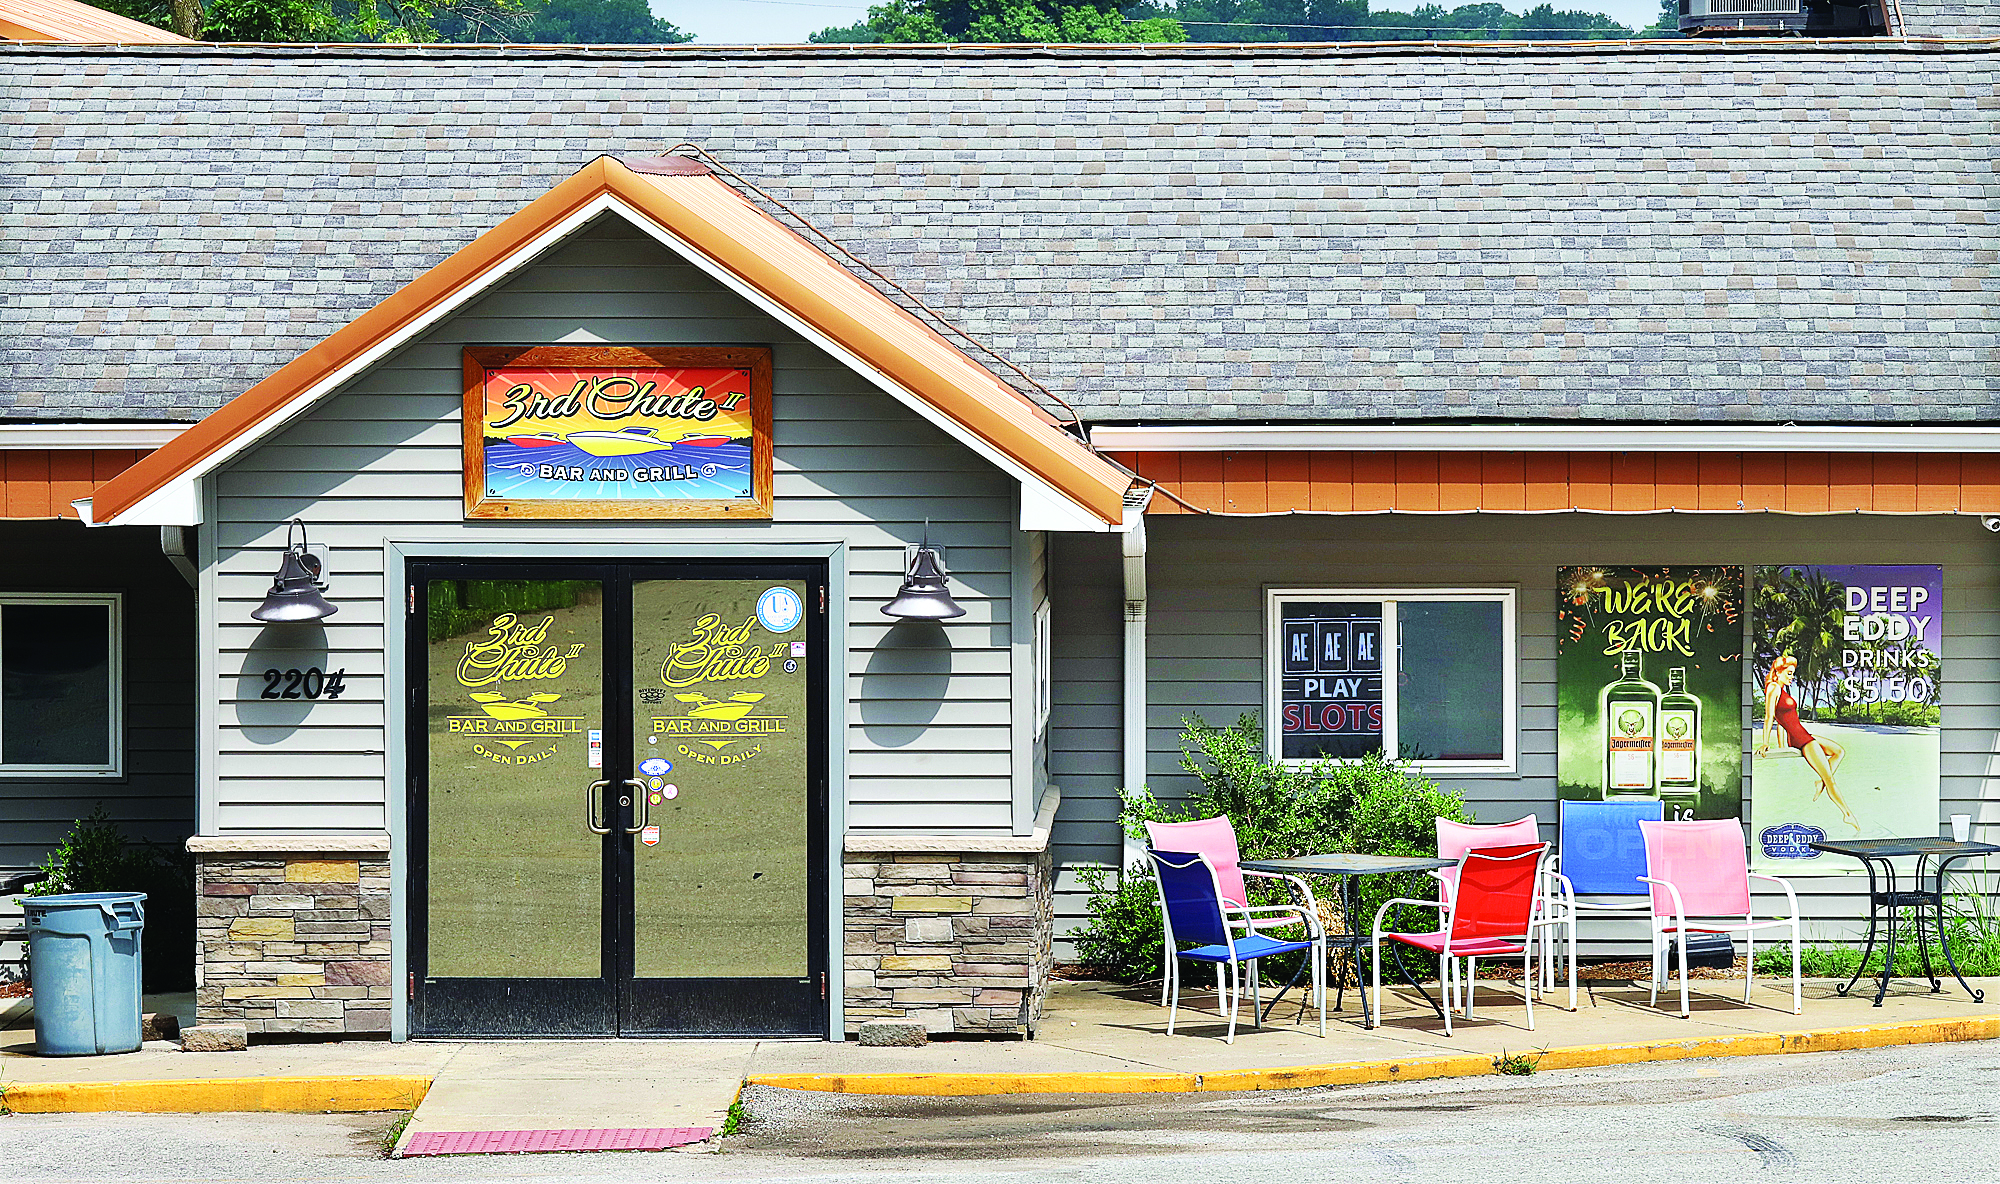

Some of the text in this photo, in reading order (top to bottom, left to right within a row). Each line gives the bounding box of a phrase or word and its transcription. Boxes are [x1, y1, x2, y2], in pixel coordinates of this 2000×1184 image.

[489, 379, 588, 428] 3rd
[585, 376, 719, 420] Chute
[538, 463, 698, 482] BAR AND GRILL
[1593, 578, 1695, 619] WE'RE
[1845, 586, 1929, 612] DEEP
[474, 612, 554, 648] 3rd
[678, 612, 757, 648] 3rd
[1602, 618, 1695, 657] BACK!
[1843, 615, 1931, 641] EDDY
[1291, 632, 1375, 661] AE AE AE
[1842, 650, 1929, 668] DRINKS
[456, 642, 567, 687] Chute
[660, 642, 771, 688] Chute
[261, 667, 346, 699] 2204
[1304, 678, 1362, 698] PLAY
[1843, 675, 1928, 707] $5.50
[449, 720, 582, 733] BAR AND GRILL
[653, 720, 786, 733] BAR AND GRILL
[1283, 704, 1382, 731] SLOTS
[472, 743, 559, 765] OPEN DAILY
[676, 744, 763, 765] OPEN DAILY
[1766, 834, 1819, 844] DEEP EDDY
